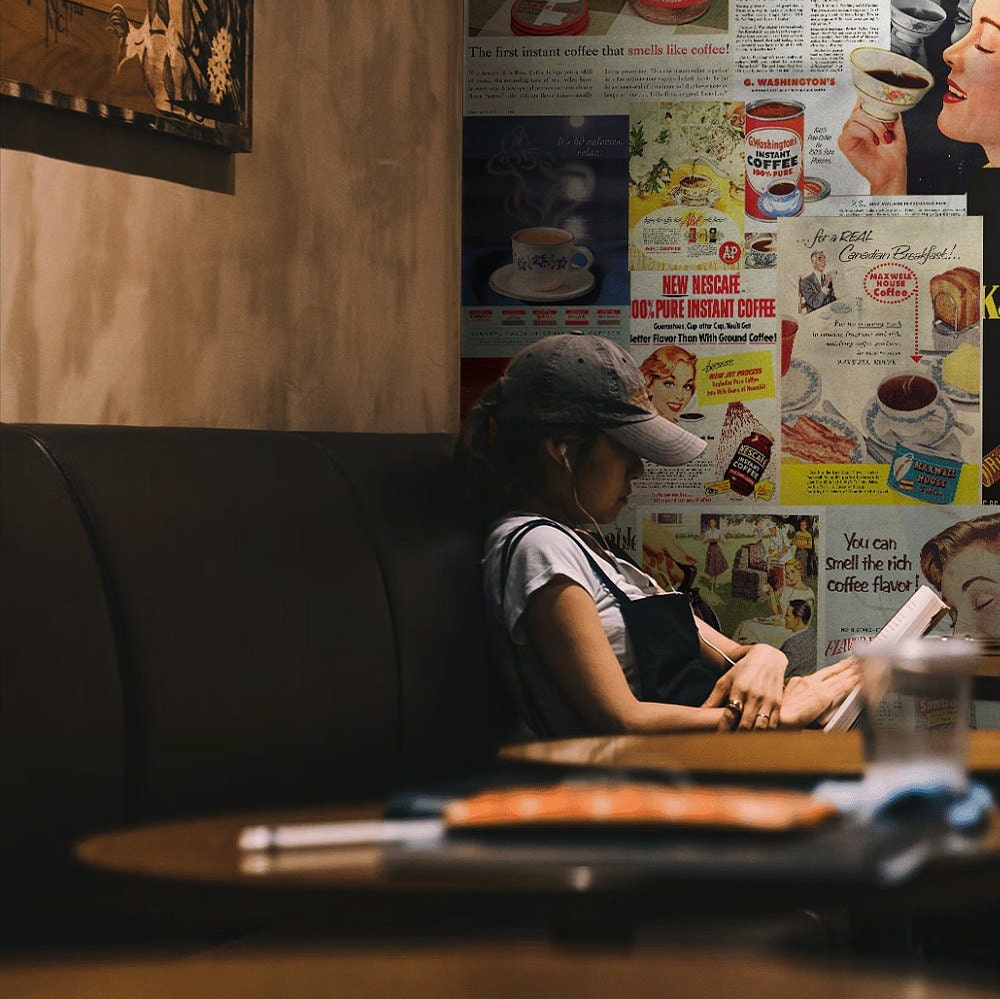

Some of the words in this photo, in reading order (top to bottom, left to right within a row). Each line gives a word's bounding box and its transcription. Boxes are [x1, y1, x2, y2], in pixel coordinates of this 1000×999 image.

[468, 46, 493, 58] The
[495, 46, 519, 57] first
[522, 46, 561, 57] instant
[564, 45, 599, 57] coffee
[602, 45, 625, 56] that
[628, 45, 664, 56] smells
[667, 43, 688, 55] like
[756, 150, 791, 159] INSTANT
[747, 156, 798, 169] COFFEE
[773, 168, 793, 177] PURE
[839, 231, 873, 242] REAL
[662, 275, 688, 295] NEW
[693, 272, 740, 294] NESCAFÉ
[874, 287, 908, 297] Coffee
[656, 300, 684, 318] PURE
[688, 299, 736, 318] INSTANT
[738, 299, 776, 317] COFFEE
[653, 334, 677, 343] Flavor
[678, 334, 697, 343] Than
[699, 333, 718, 343] With
[719, 333, 747, 343] Ground
[844, 532, 869, 551] You
[872, 537, 897, 550] can
[826, 556, 860, 571] smell
[862, 556, 885, 571] the
[888, 557, 912, 571] rich
[827, 578, 868, 594] coffee
